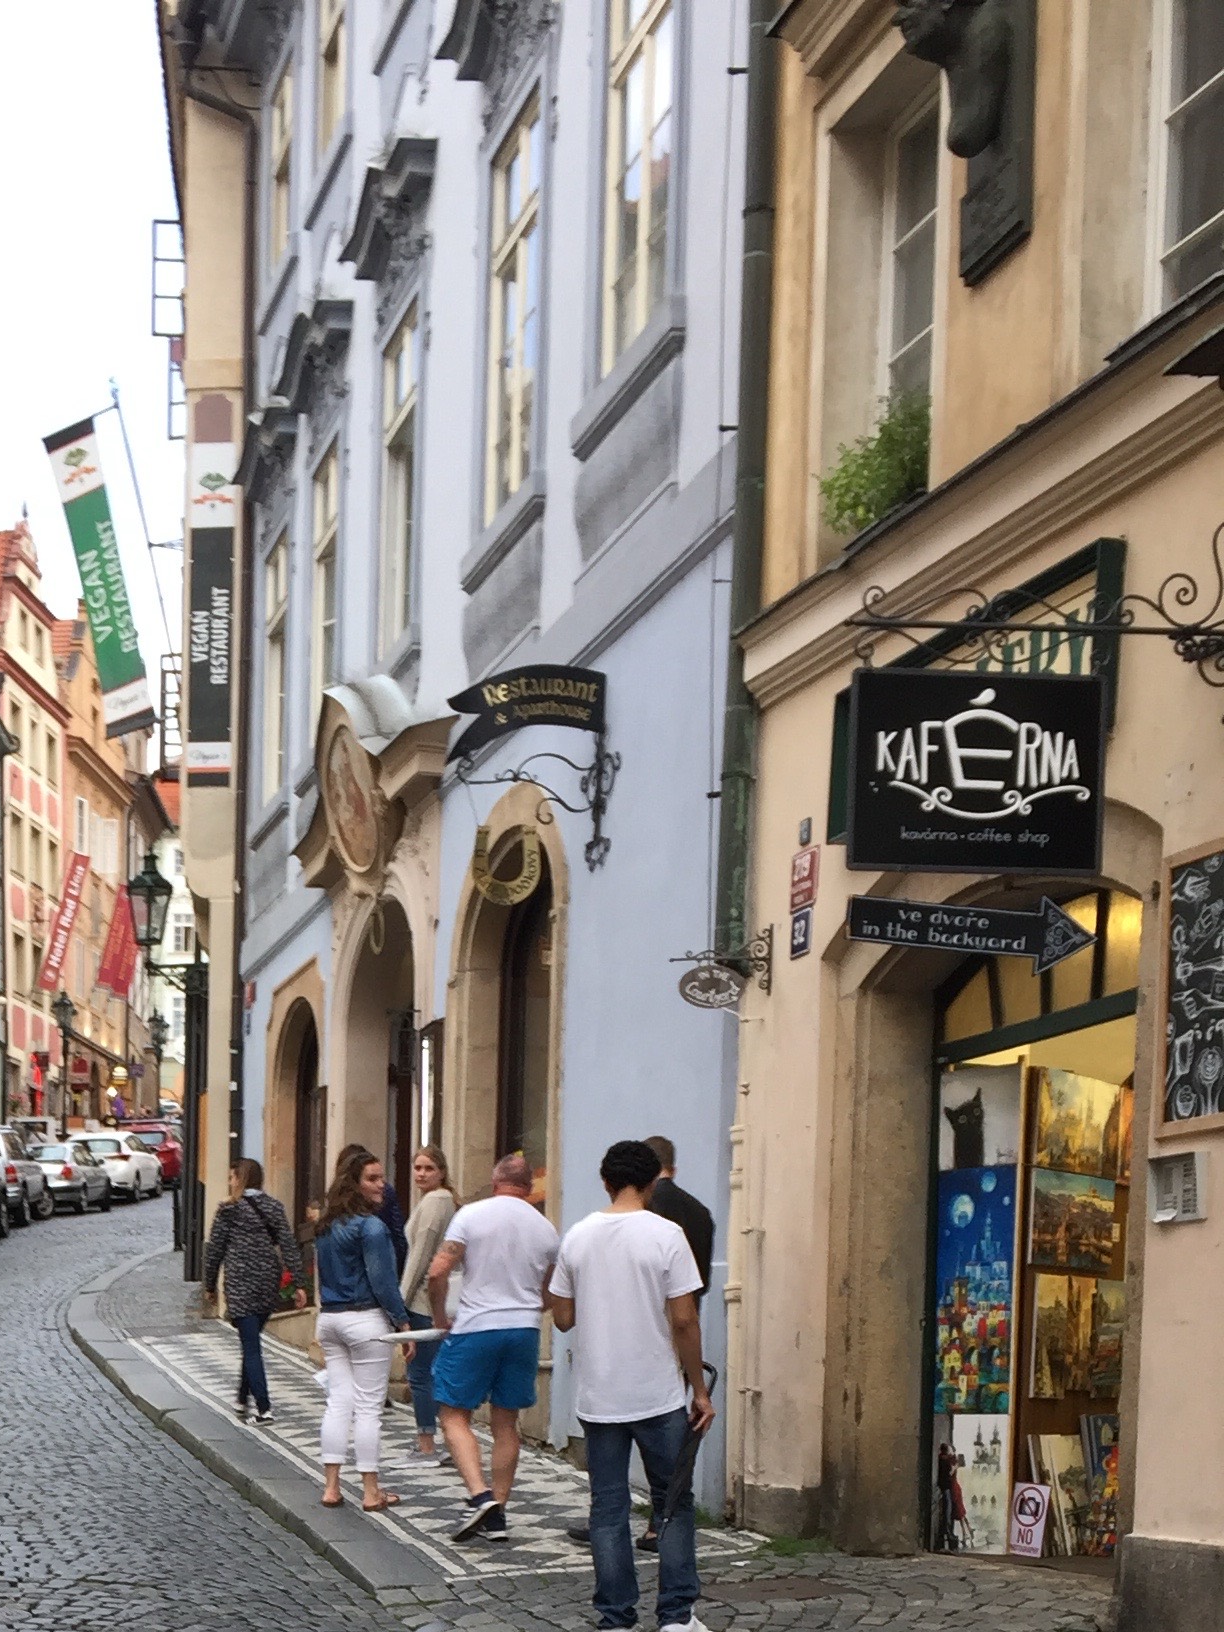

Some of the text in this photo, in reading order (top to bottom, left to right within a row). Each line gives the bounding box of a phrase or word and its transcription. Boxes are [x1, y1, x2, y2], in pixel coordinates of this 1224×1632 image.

[78, 549, 113, 644] VEGAN
[95, 520, 137, 653] RESTAURANT
[191, 611, 210, 662] VEGAN
[210, 586, 230, 684] RESTAURANT
[967, 828, 1012, 843] coffee
[1017, 829, 1050, 848] shop
[48, 865, 85, 968] Hotel Red Lion
[862, 920, 1026, 951] in the backyard
[898, 908, 922, 922] ve
[1017, 1527, 1033, 1545] NO
